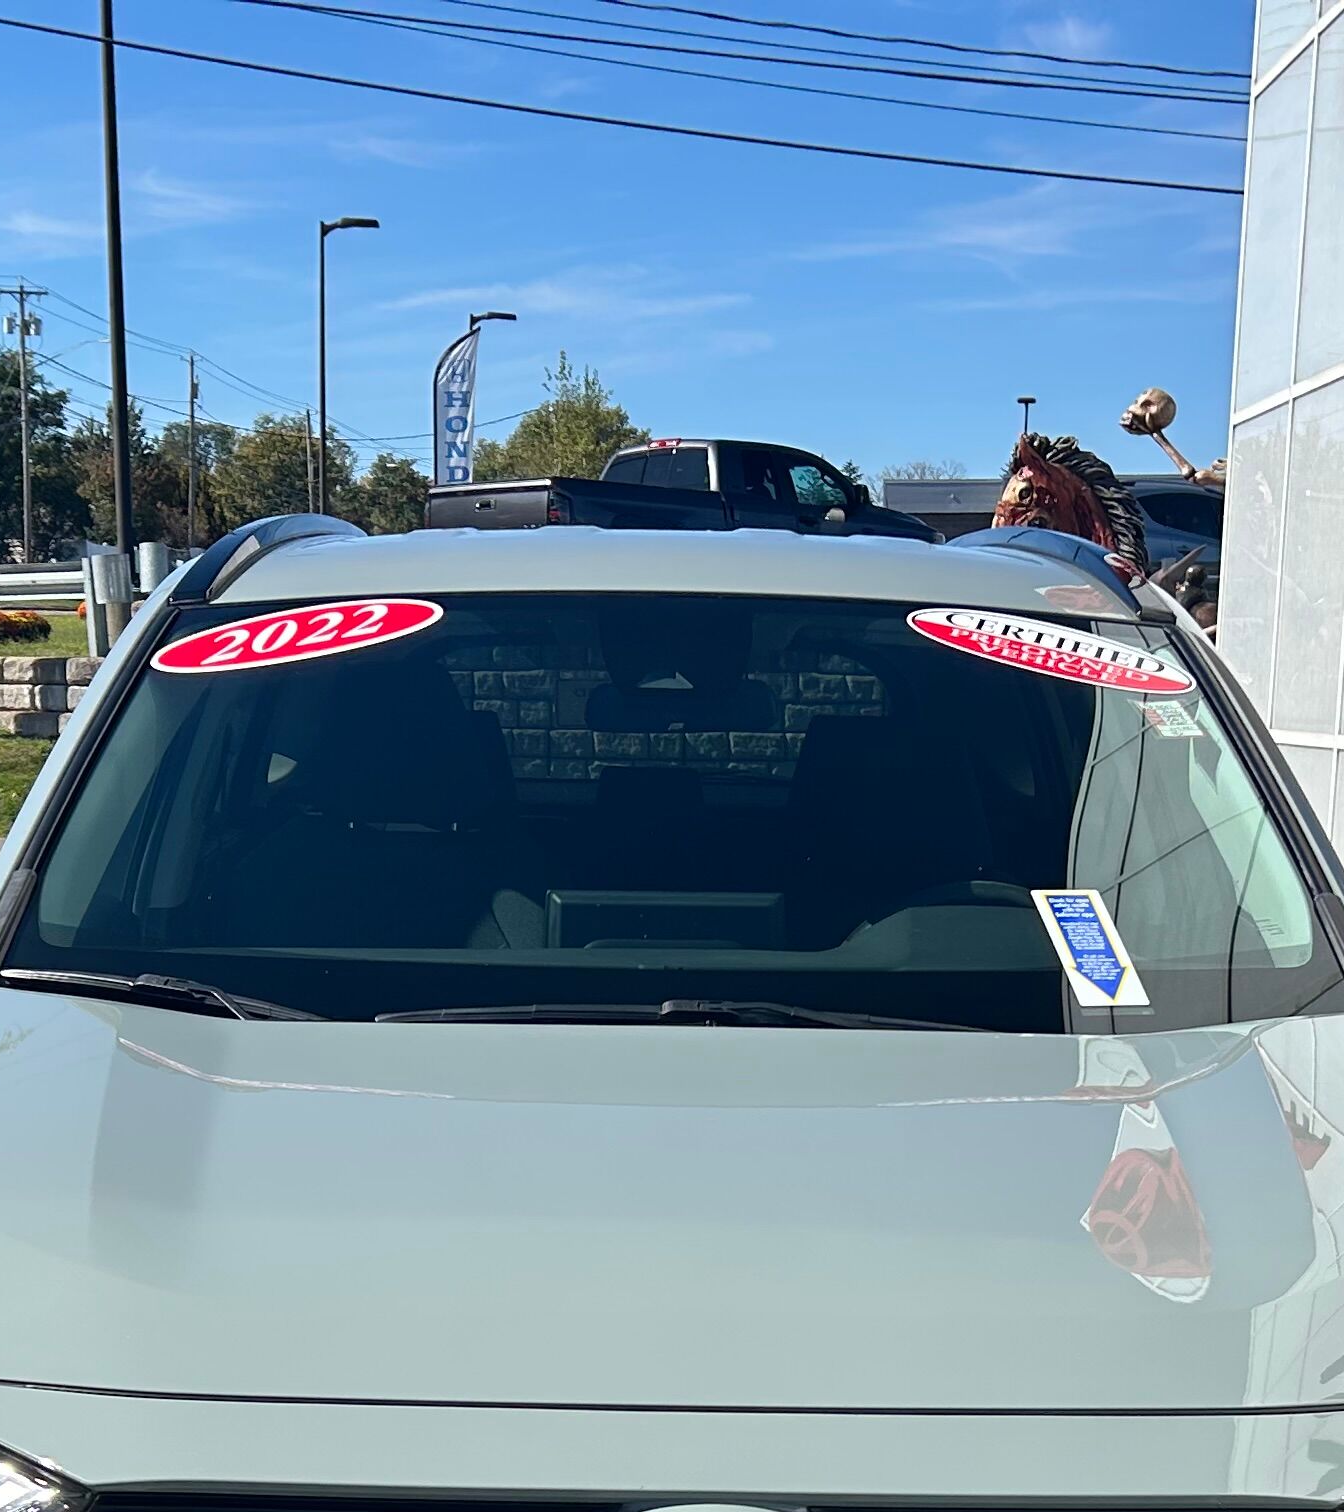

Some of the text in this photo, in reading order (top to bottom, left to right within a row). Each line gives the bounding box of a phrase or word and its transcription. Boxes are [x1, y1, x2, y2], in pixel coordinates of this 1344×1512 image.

[444, 391, 471, 483] HOND
[200, 604, 388, 666] 2022
[946, 613, 1164, 674] CERTIFIED
[949, 628, 1151, 682] PRE-OWNED
[975, 642, 1119, 684] VEHICLE
